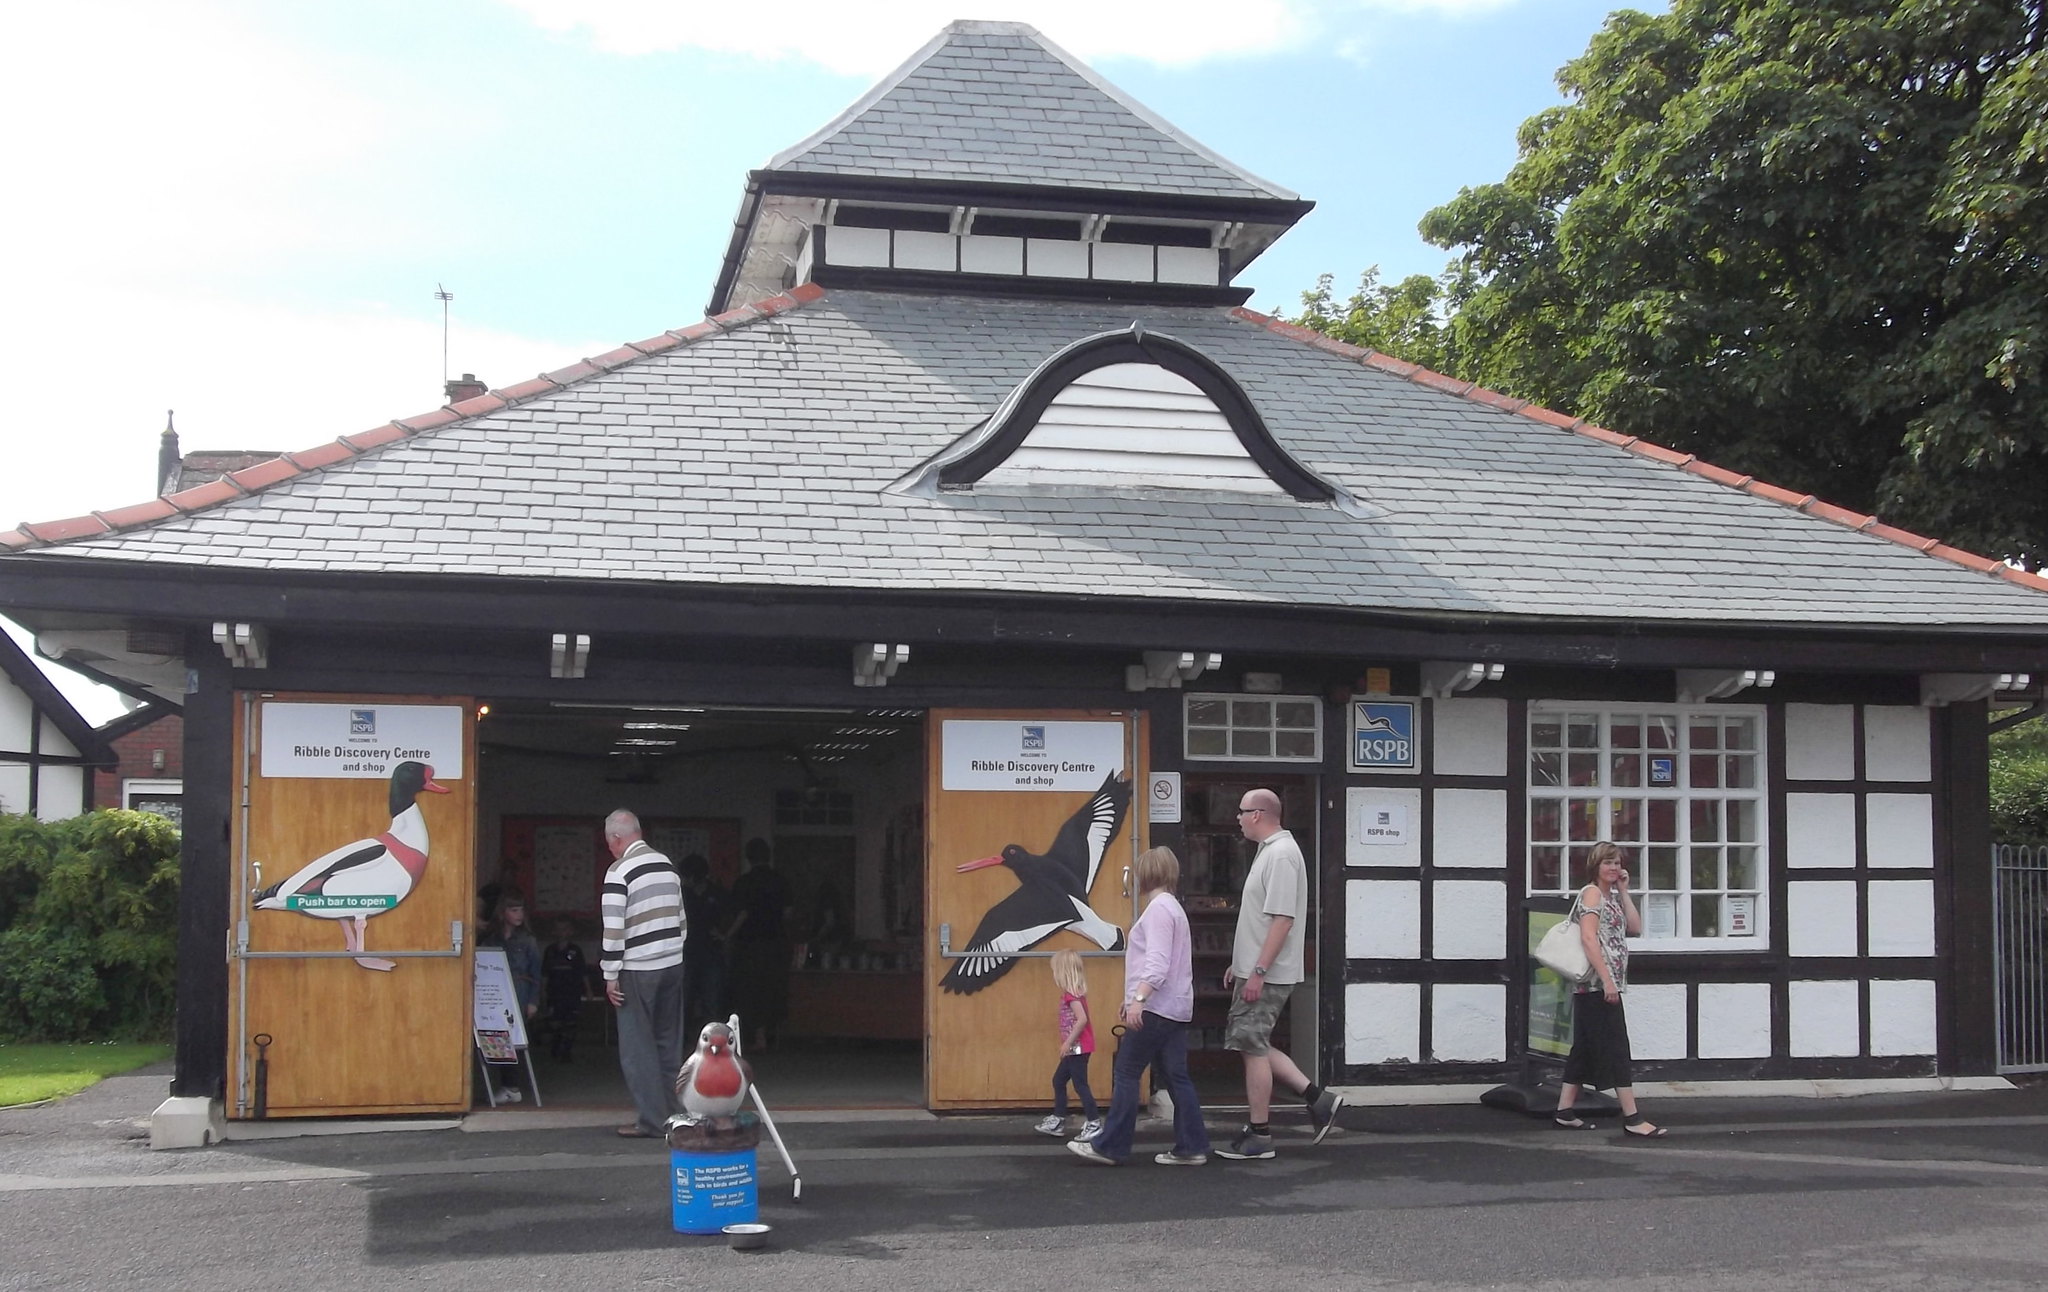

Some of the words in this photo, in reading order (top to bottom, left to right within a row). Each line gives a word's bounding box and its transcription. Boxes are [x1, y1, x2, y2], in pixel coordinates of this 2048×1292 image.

[352, 723, 374, 732] RSPB
[1024, 739, 1043, 748] RSPB
[294, 745, 331, 757] Ribble
[334, 746, 391, 760] Discovery
[394, 747, 431, 759] Centre
[1359, 739, 1409, 761] RSPB
[342, 762, 360, 772] and
[362, 762, 385, 773] shop
[971, 760, 1004, 771] Ribble
[1007, 760, 1059, 774] Discovery
[1061, 761, 1095, 772] Centre
[1015, 776, 1031, 785] and
[1033, 776, 1054, 787] shop
[1367, 828, 1385, 836] RSPB
[1385, 828, 1400, 838] shop
[298, 897, 324, 906] Push
[327, 897, 344, 906] bar
[347, 898, 358, 906] to
[360, 898, 386, 907] open
